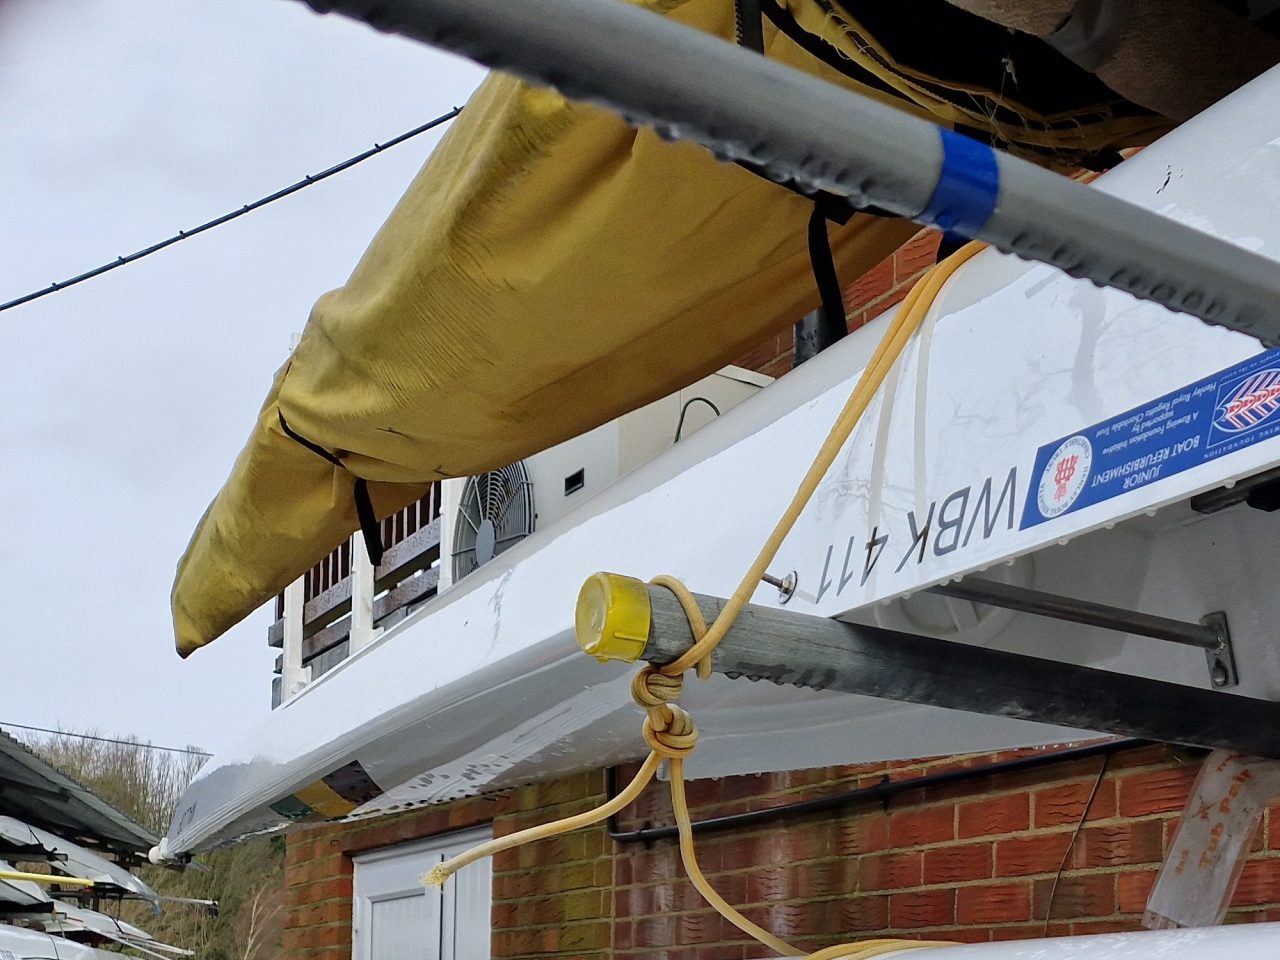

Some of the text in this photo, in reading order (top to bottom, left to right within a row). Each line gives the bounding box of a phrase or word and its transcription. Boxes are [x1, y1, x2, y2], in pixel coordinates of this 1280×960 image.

[1095, 382, 1217, 438] Henley Royal Regatta Charitable Trust
[1131, 410, 1174, 433] supported by
[1102, 411, 1200, 455] A Rowing Foundation Initiative
[1203, 435, 1254, 459] FOUNDATION
[1091, 435, 1200, 487] BOAT REFURBISHMENT
[1123, 464, 1162, 489] JUNIOR
[816, 465, 1017, 605] WBK 411
